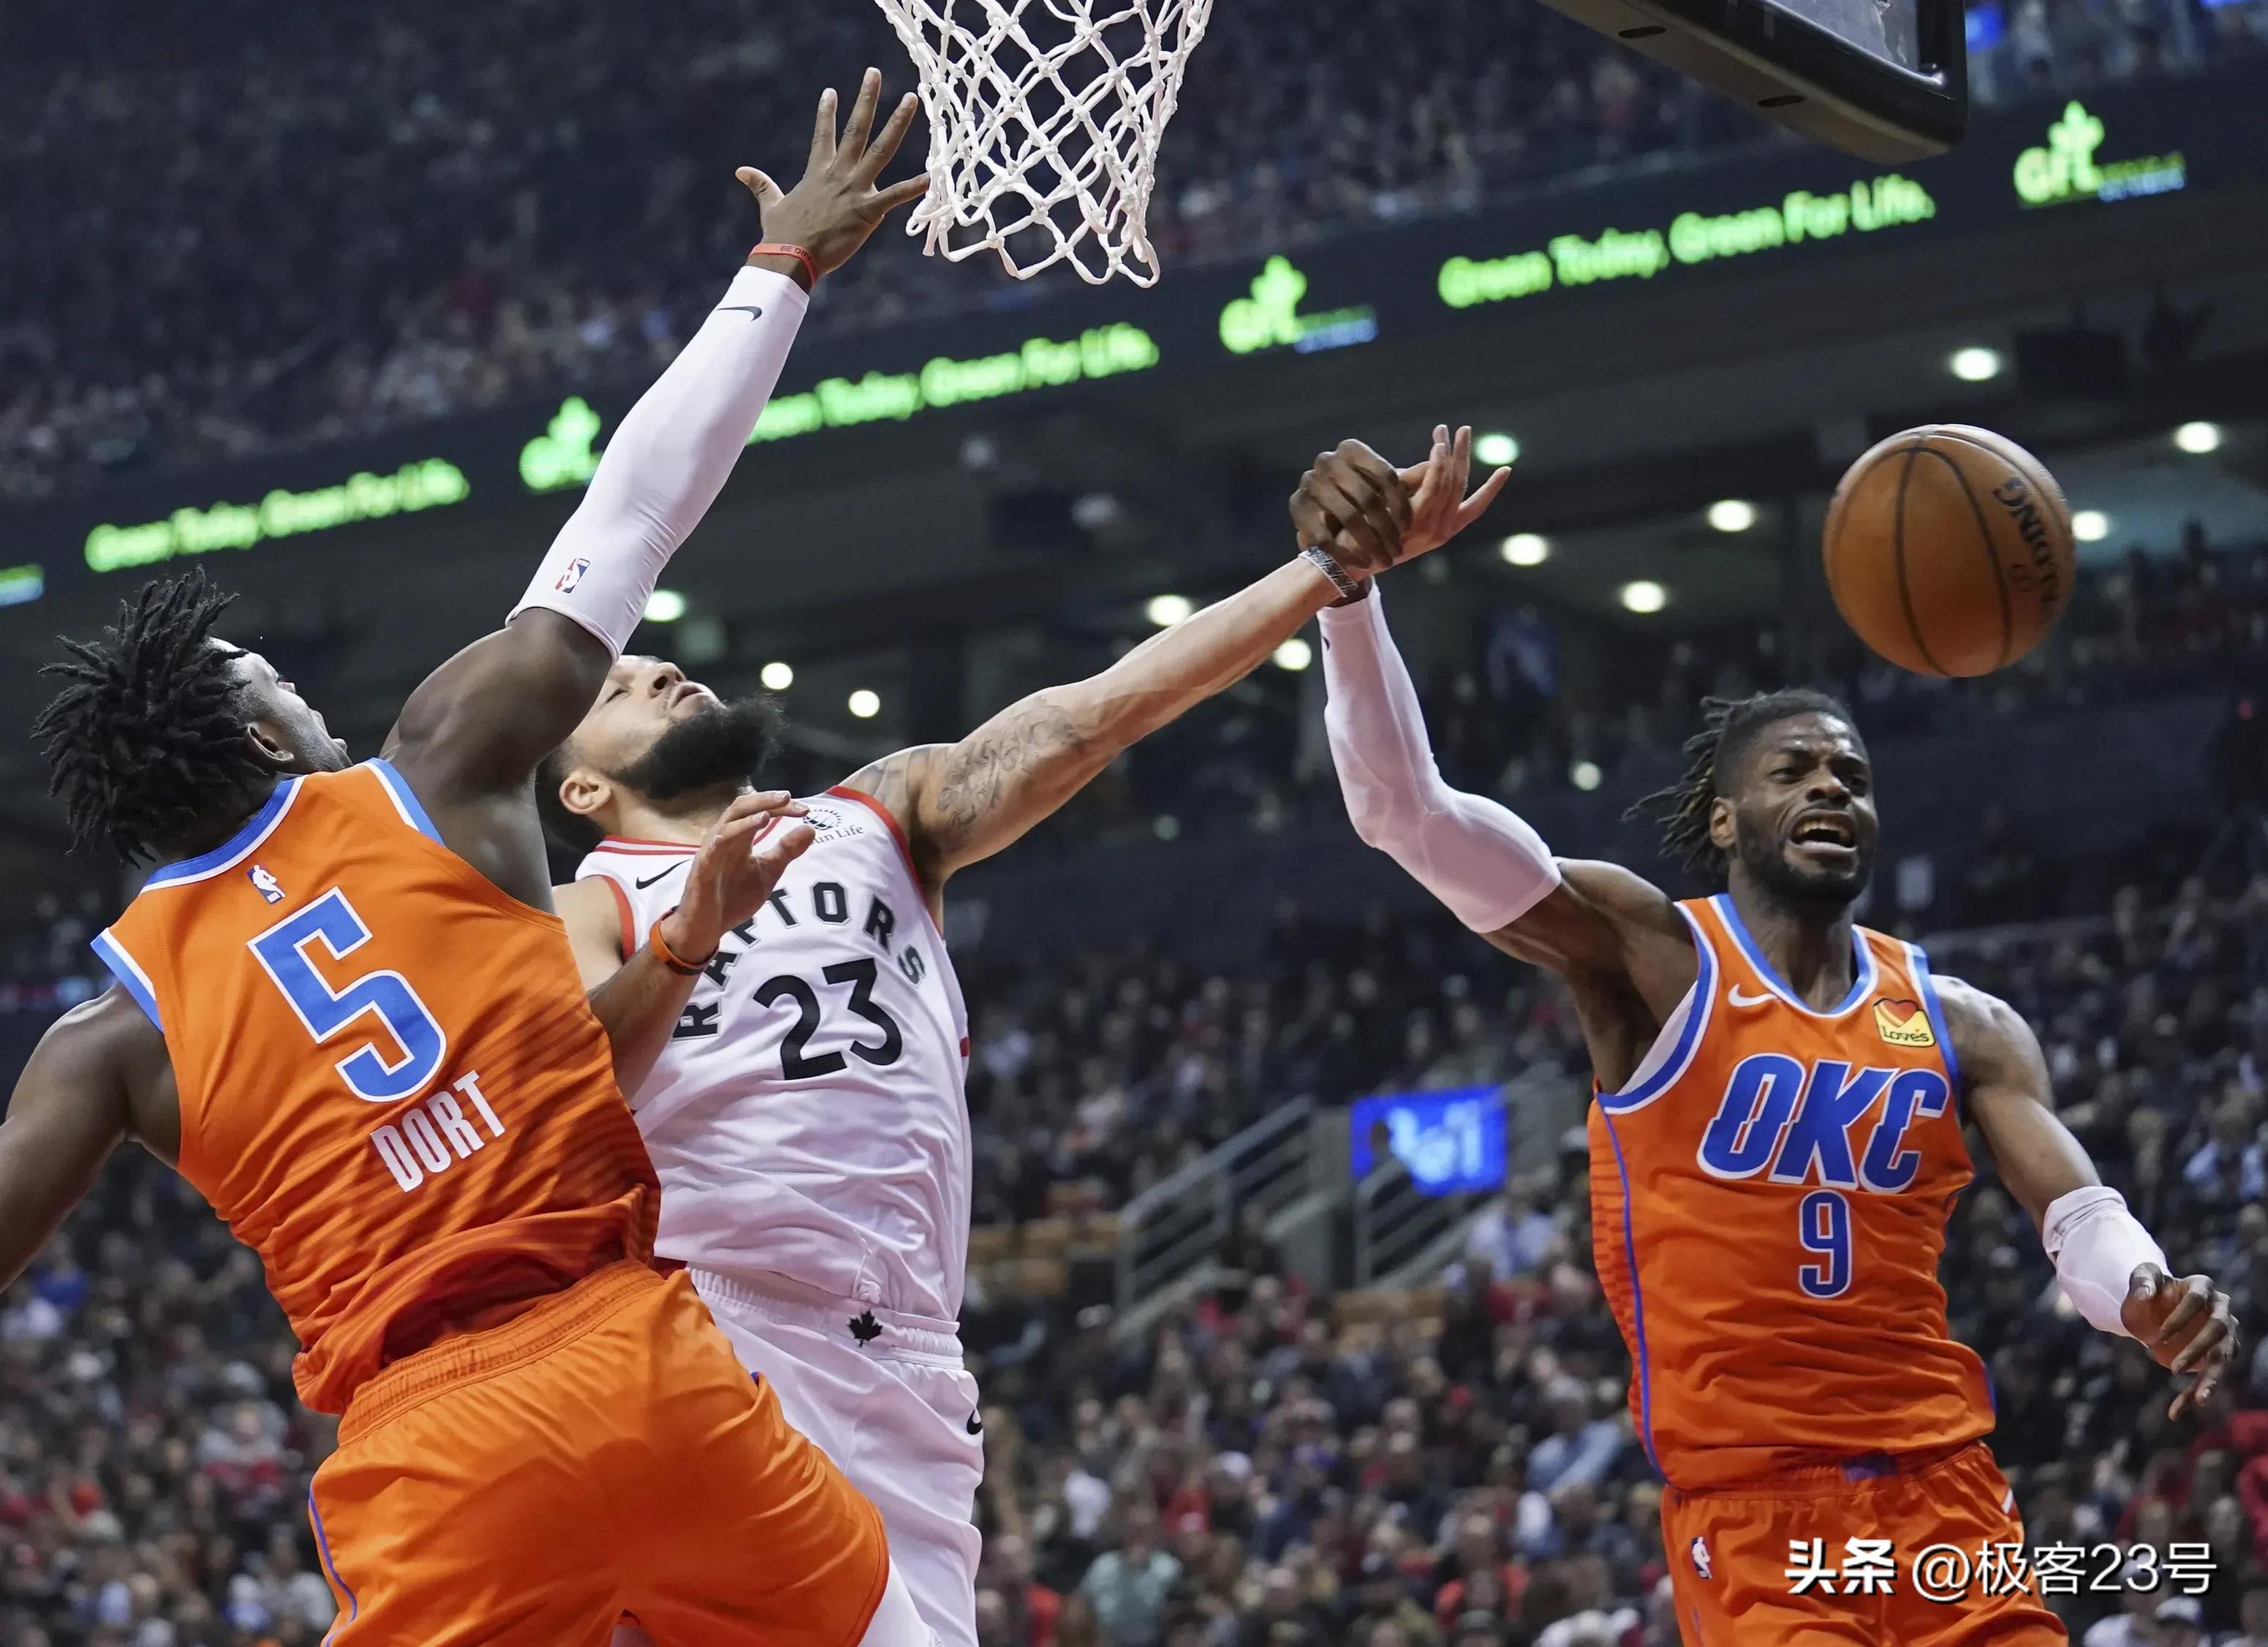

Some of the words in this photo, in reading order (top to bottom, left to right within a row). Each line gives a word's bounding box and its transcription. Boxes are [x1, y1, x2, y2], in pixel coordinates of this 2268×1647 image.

[812, 834, 834, 844] un
[836, 825, 865, 838] Life
[247, 886, 447, 1102] 5
[752, 958, 902, 1080] 23
[370, 1069, 505, 1192] DORT
[1696, 1053, 1951, 1194] OKC
[1798, 1189, 1852, 1298] 9
